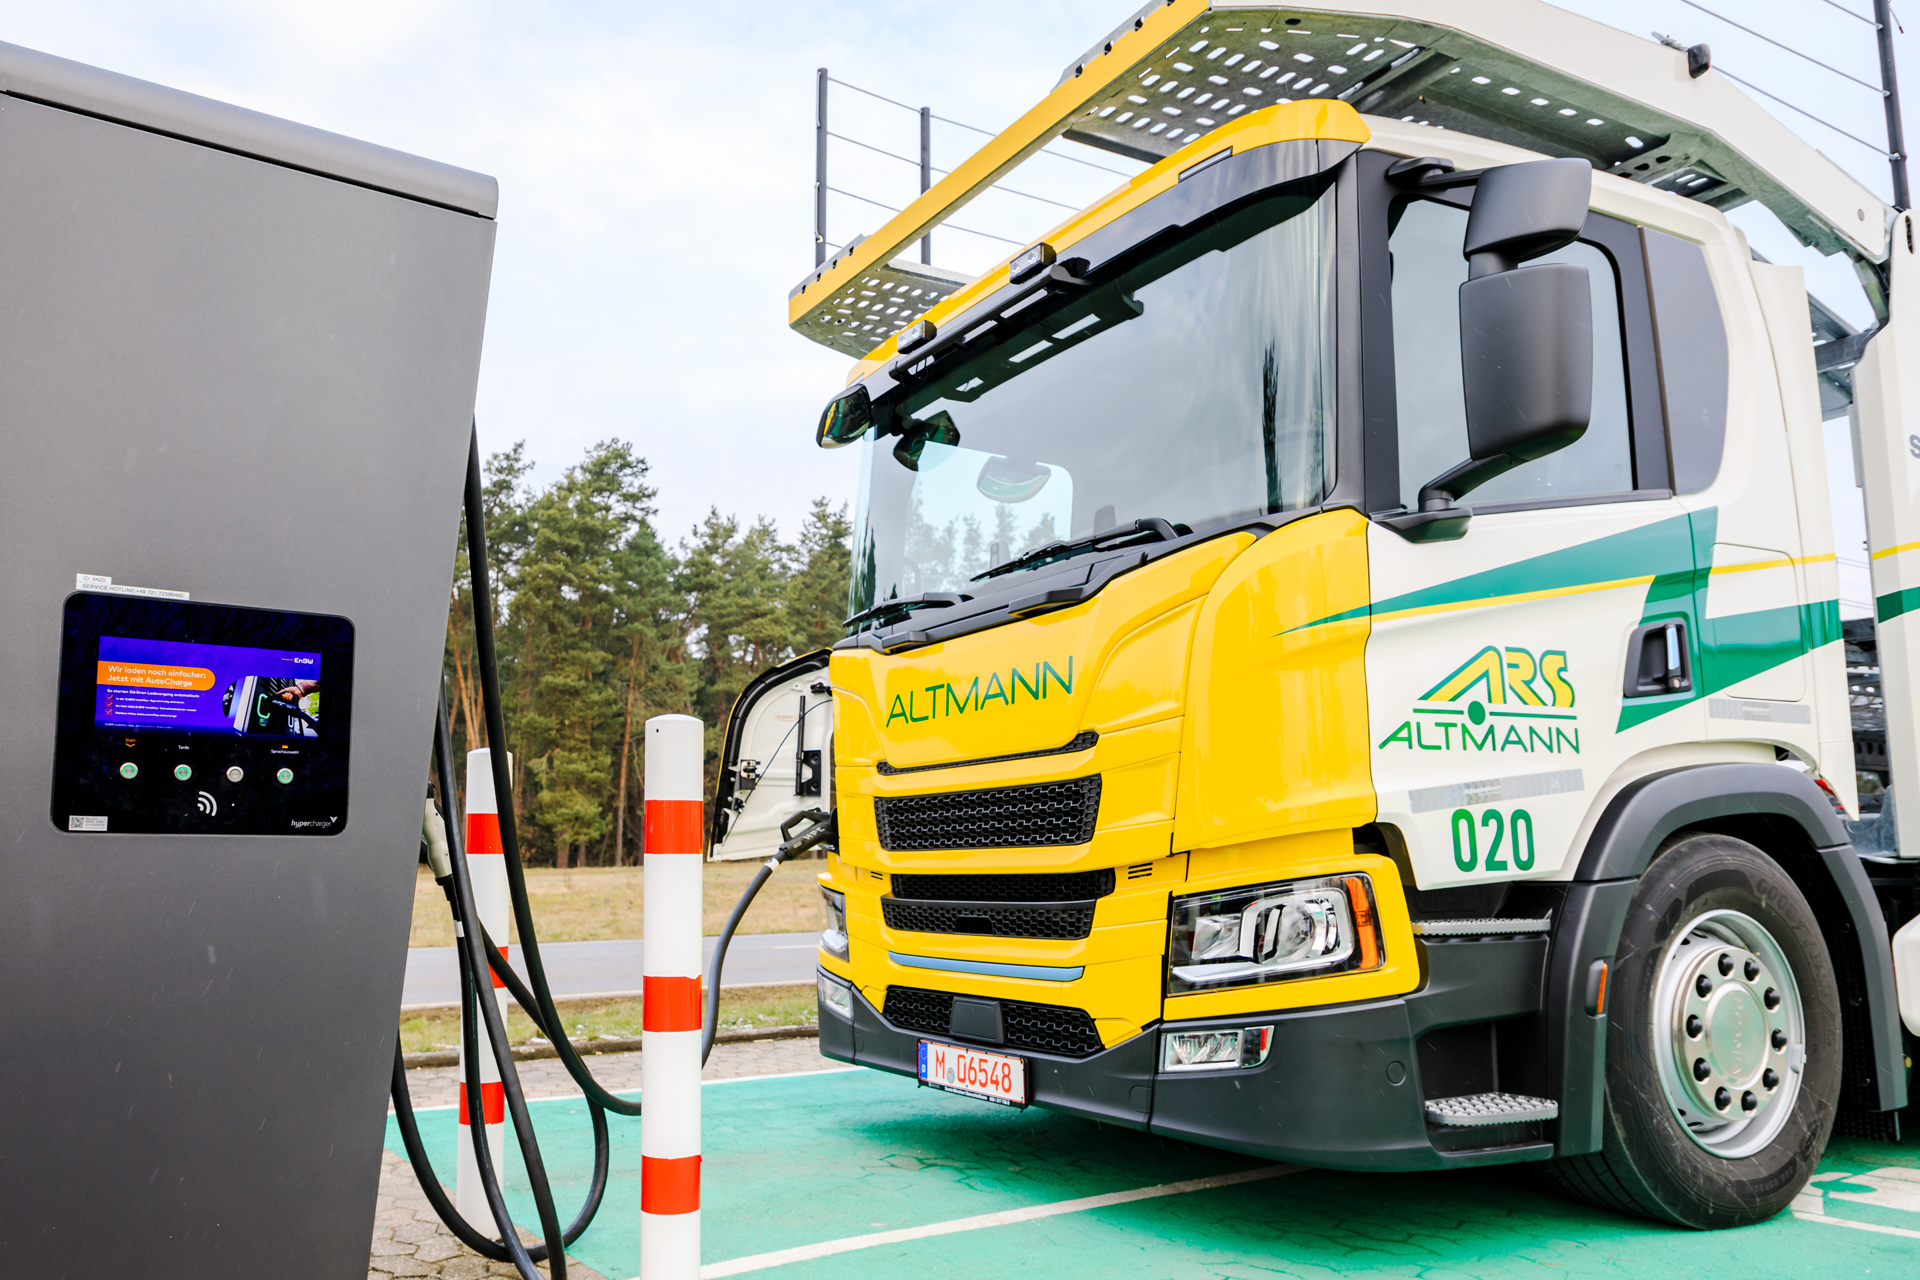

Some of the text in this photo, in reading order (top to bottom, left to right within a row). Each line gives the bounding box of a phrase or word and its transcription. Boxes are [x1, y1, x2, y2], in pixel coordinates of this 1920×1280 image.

[82, 583, 108, 591] SERVICE
[107, 665, 206, 679] Wir laden noch einfacher:
[107, 674, 129, 683] Jetzt
[145, 676, 193, 688] AutoCharge
[1416, 645, 1575, 708] ARS
[886, 655, 1073, 728] ALTMANN
[1378, 720, 1581, 755] ALTMANN
[291, 819, 332, 829] hypercharger
[1451, 808, 1535, 873] 020
[935, 1049, 946, 1080] M
[957, 1053, 1012, 1094] 06548
